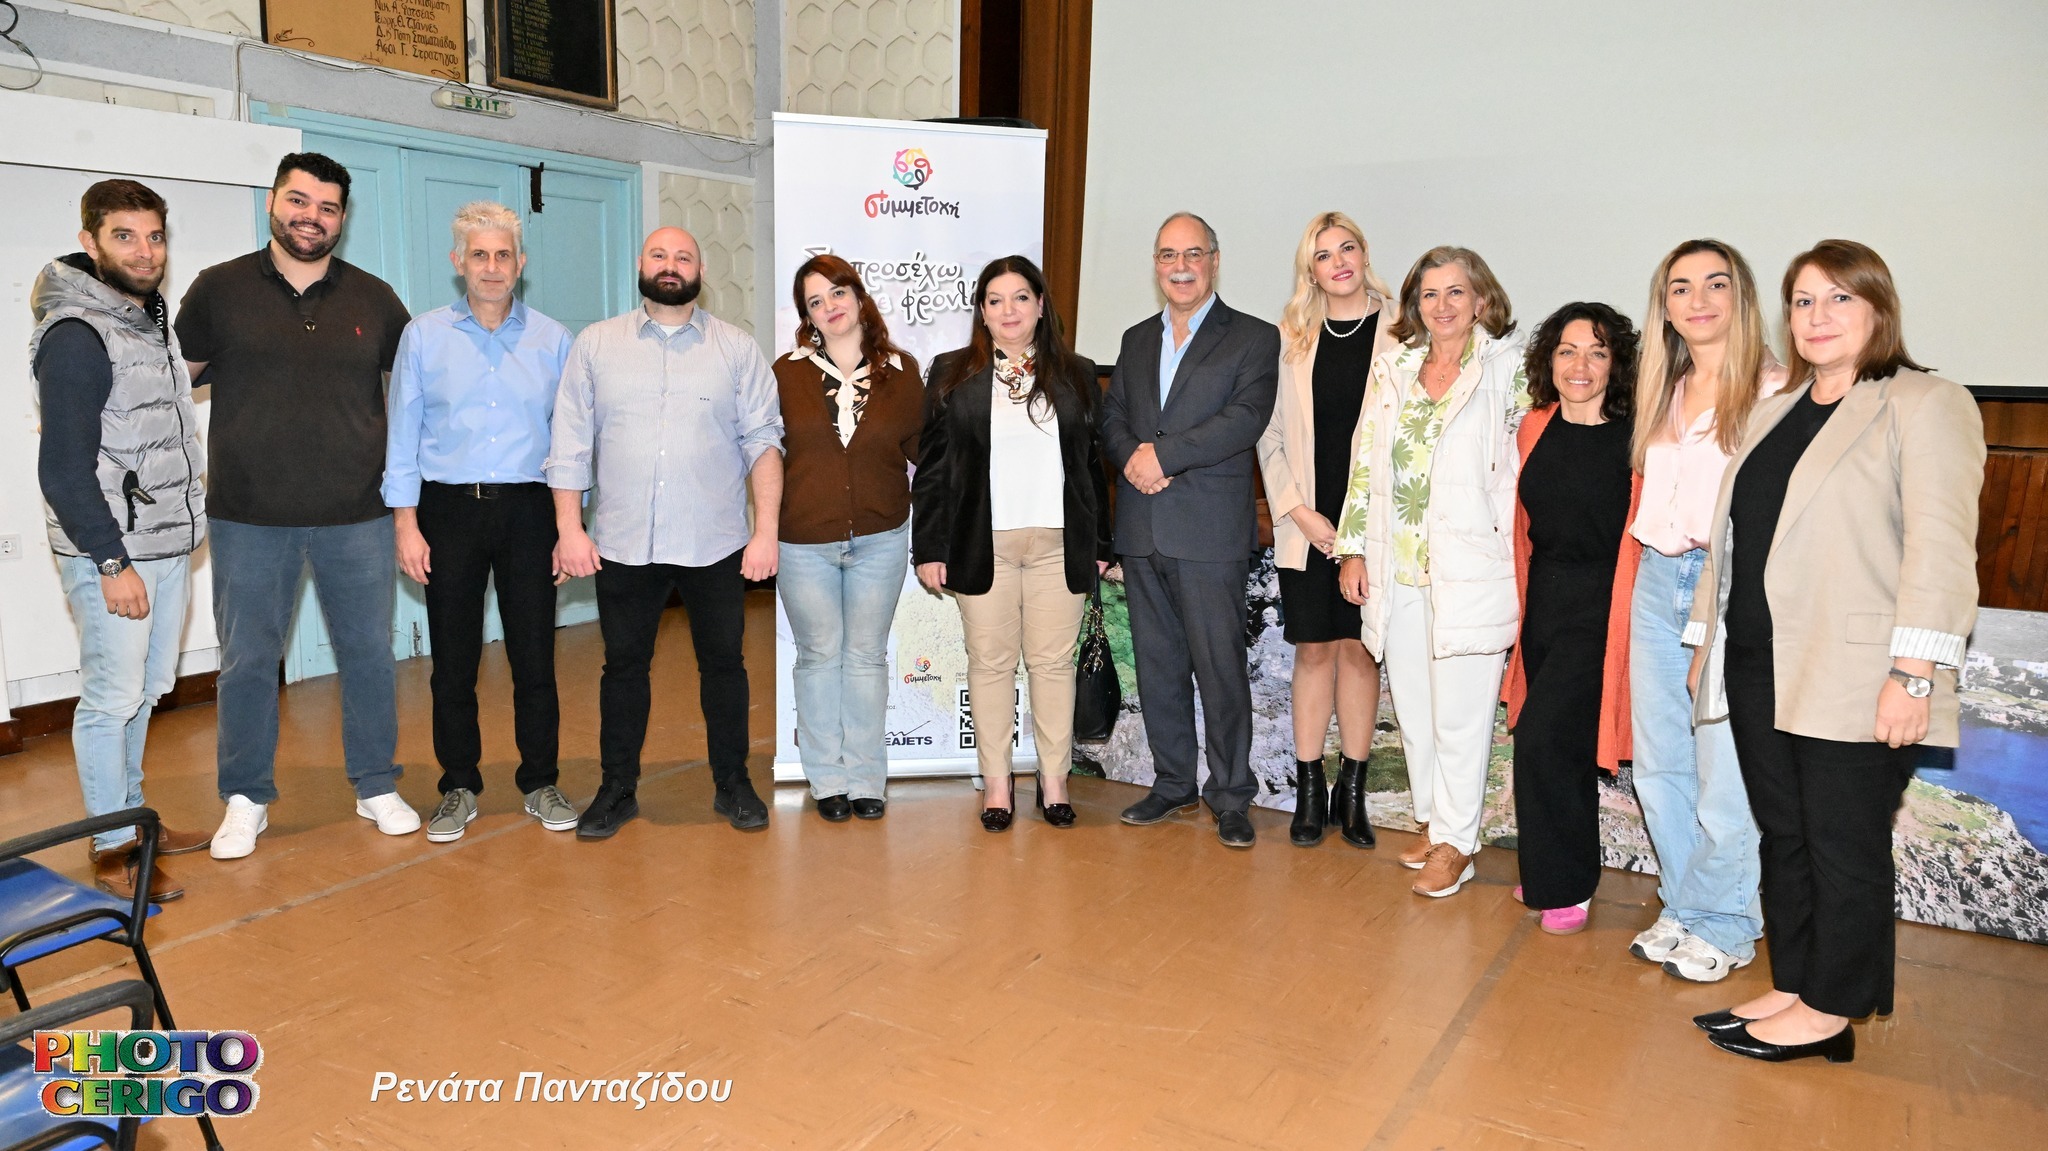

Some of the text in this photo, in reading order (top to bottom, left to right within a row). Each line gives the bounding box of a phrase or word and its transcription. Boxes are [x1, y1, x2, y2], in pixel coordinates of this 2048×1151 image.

[465, 96, 500, 112] EXIT
[901, 280, 977, 321] φροντί
[885, 736, 933, 747] EAJETS
